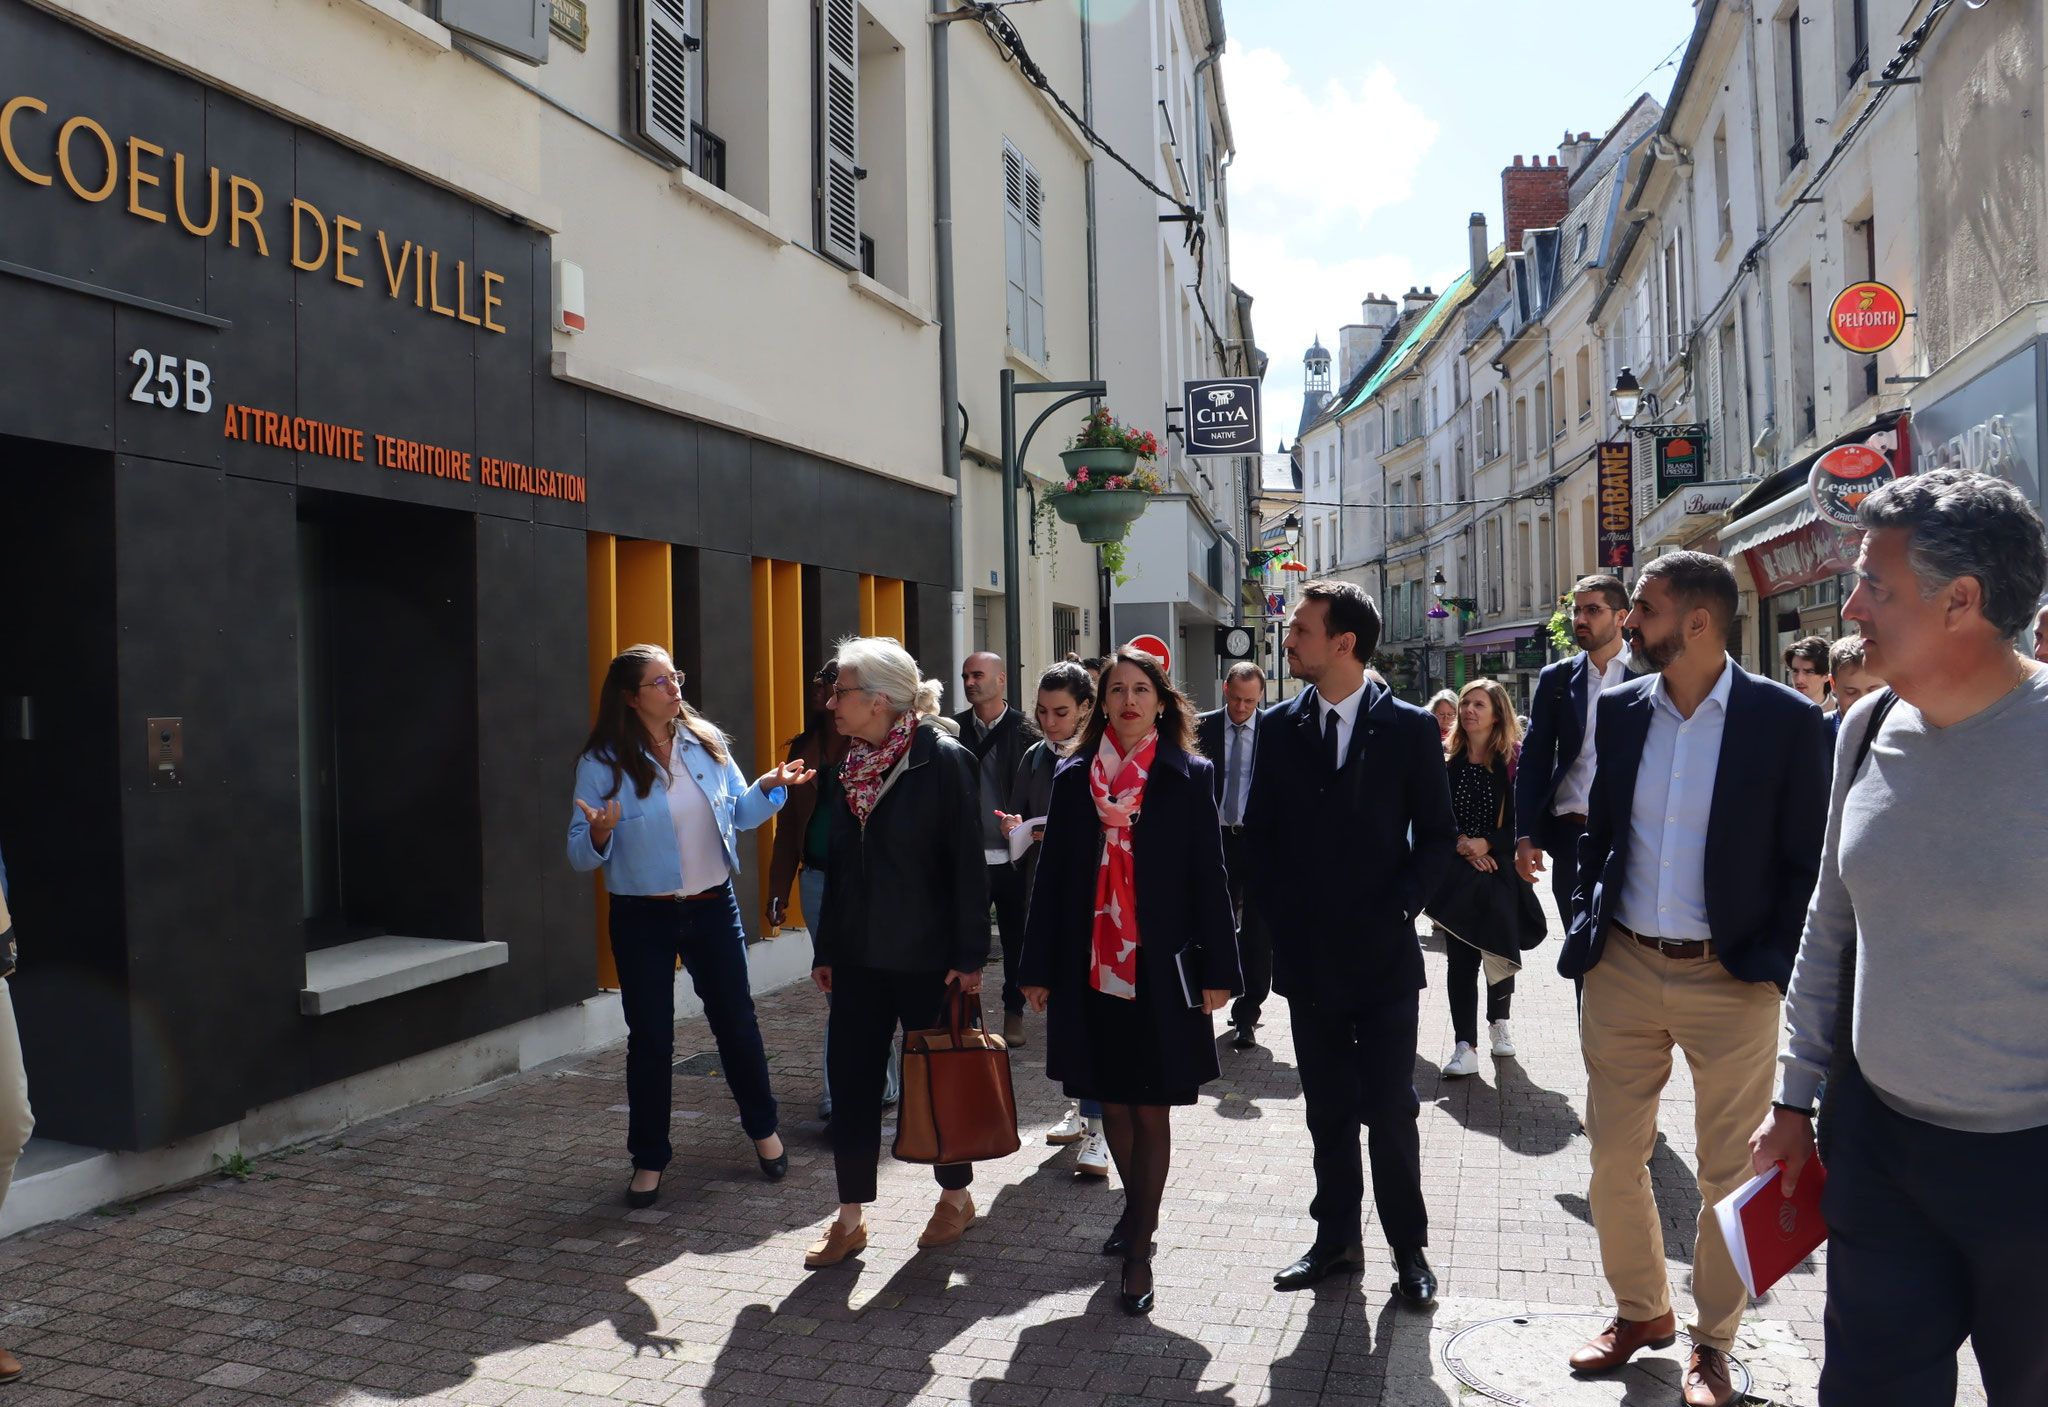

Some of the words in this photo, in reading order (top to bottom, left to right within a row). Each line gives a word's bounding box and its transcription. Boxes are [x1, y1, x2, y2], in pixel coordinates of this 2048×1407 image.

[553, 8, 571, 28] RUE
[0, 96, 269, 256] COEUR
[293, 198, 363, 288] DE
[378, 230, 506, 334] VILLE
[1838, 311, 1897, 328] PELFORTH
[131, 348, 213, 414] 25B
[224, 403, 364, 461] ATTRACTIVITE
[375, 434, 472, 482] TERRITOIRE
[480, 457, 586, 503] REVITALISATION
[1211, 431, 1236, 440] NATIVE
[1602, 446, 1630, 531] CABANE
[1819, 498, 1835, 515] THE
